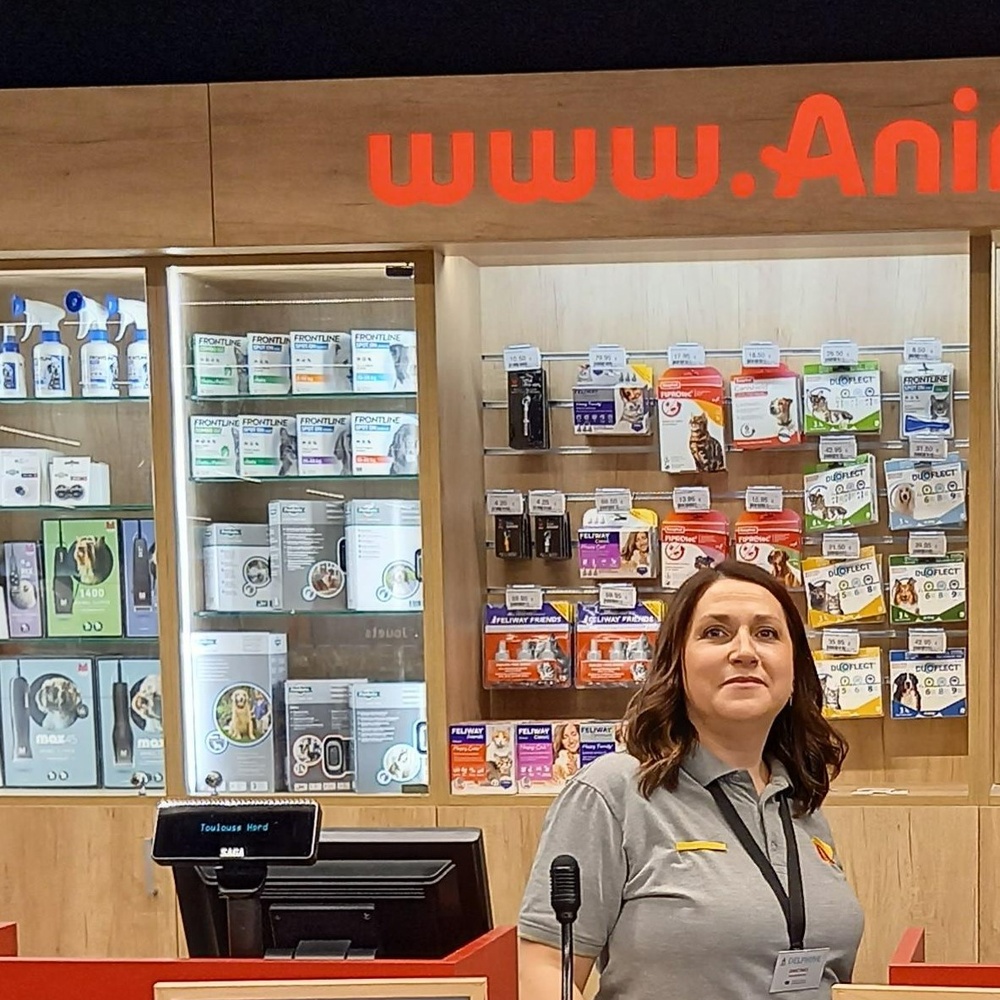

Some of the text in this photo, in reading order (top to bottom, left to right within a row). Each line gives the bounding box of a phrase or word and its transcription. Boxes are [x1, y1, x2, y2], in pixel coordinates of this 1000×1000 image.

[199, 337, 241, 347] FRONTLINE
[252, 335, 291, 345] FRONTLIN
[294, 334, 340, 343] FRONTLINE
[355, 333, 401, 342] FRONTLINE
[904, 375, 947, 384] FRONTLINE
[194, 419, 239, 427] FRONTLINE
[242, 418, 288, 426] FRONTLINE
[300, 417, 346, 425] FRONTLINE
[355, 416, 401, 424] FRONTLINE
[825, 469, 865, 483] DUOFLECT
[912, 470, 955, 481] DUOFLECT
[828, 562, 871, 577] DUOFLECT
[915, 567, 959, 577] DUOFLECT
[79, 588, 105, 599] 1400
[496, 615, 562, 624] FELIWAY FRIENDS
[830, 662, 874, 672] DUOFLECT
[915, 663, 960, 673] DUOFLECT
